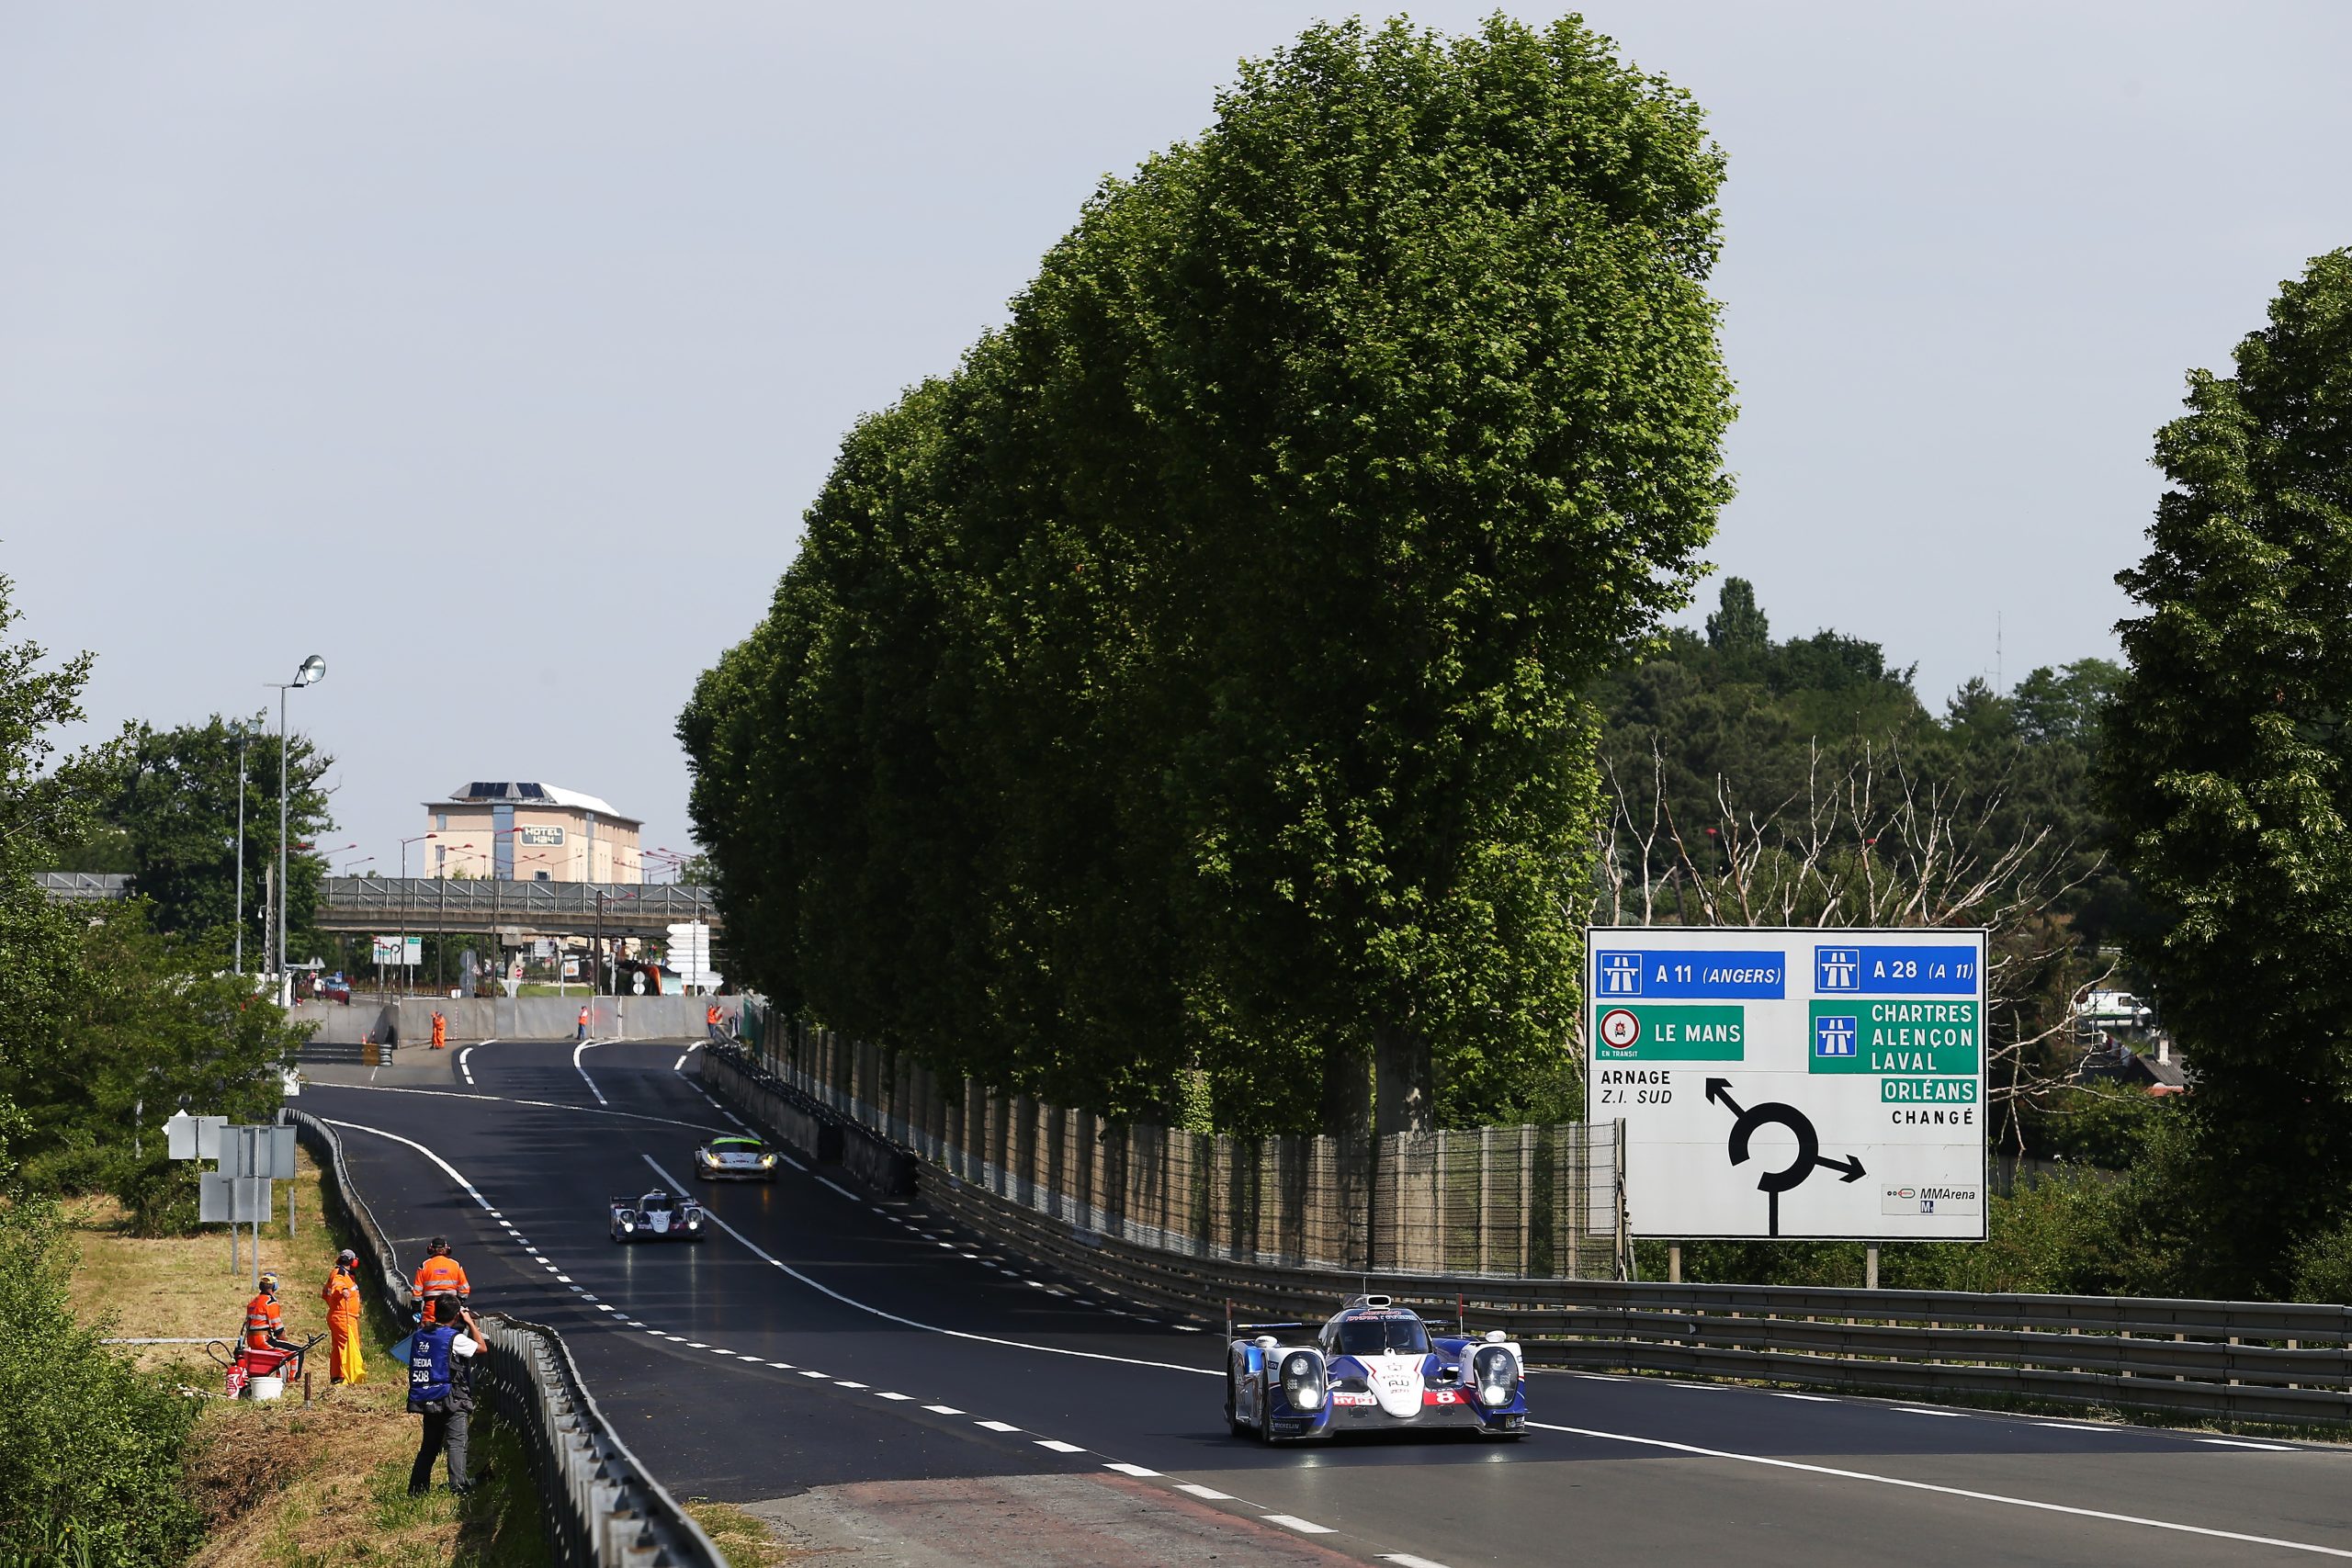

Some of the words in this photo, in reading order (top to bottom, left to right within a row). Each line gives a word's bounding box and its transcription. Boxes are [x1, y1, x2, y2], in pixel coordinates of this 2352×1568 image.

[525, 828, 561, 836] HOTEL
[1656, 964, 1668, 983] A
[1675, 964, 1691, 983] 11
[1702, 967, 1781, 985] (ANGERS)
[1873, 961, 1885, 978] A
[1892, 961, 1917, 978] 28
[1928, 963, 1946, 979] (A
[1956, 963, 1973, 979] 11)
[1871, 1004, 1973, 1022] CHARTRES
[1655, 1024, 1676, 1042] LE
[1685, 1024, 1741, 1043] MANS
[1871, 1028, 1973, 1049] ALENÇON
[1871, 1052, 1937, 1070] LAVAL
[1600, 1070, 1670, 1085] ARNAGE
[1601, 1089, 1627, 1104] Z.I.
[1636, 1089, 1672, 1104] SUD
[1884, 1079, 1973, 1100] ORLÉANS
[1892, 1108, 1973, 1125] CHANGÉ
[1919, 1188, 1975, 1200] MMArena
[413, 1358, 432, 1368] MEDIA
[413, 1370, 429, 1382] 508
[1436, 1391, 1456, 1404] 8
